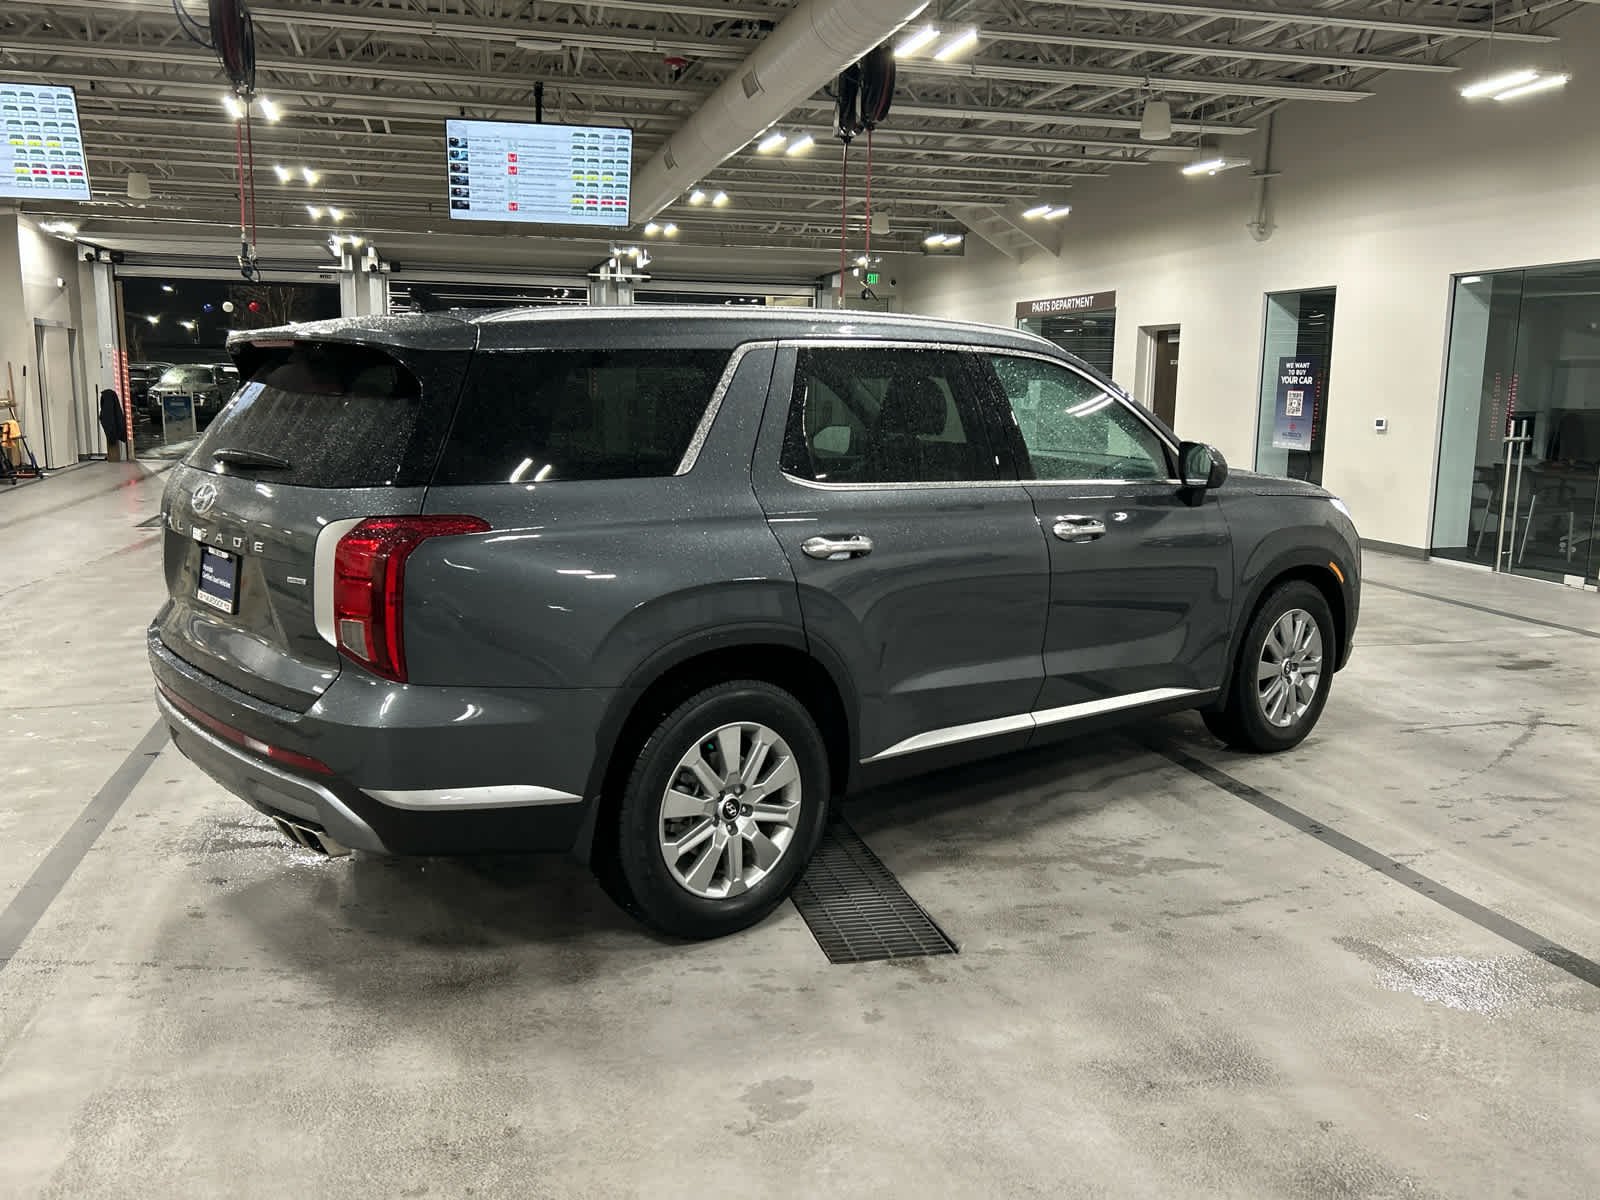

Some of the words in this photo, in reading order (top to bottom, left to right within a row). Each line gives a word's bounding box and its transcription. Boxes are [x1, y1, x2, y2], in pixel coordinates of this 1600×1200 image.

[866, 273, 879, 285] EXIT
[1031, 301, 1051, 312] PARTS
[1051, 295, 1094, 311] DEPARTMENT
[1281, 376, 1298, 384] YOUR
[1299, 376, 1312, 384] CAR
